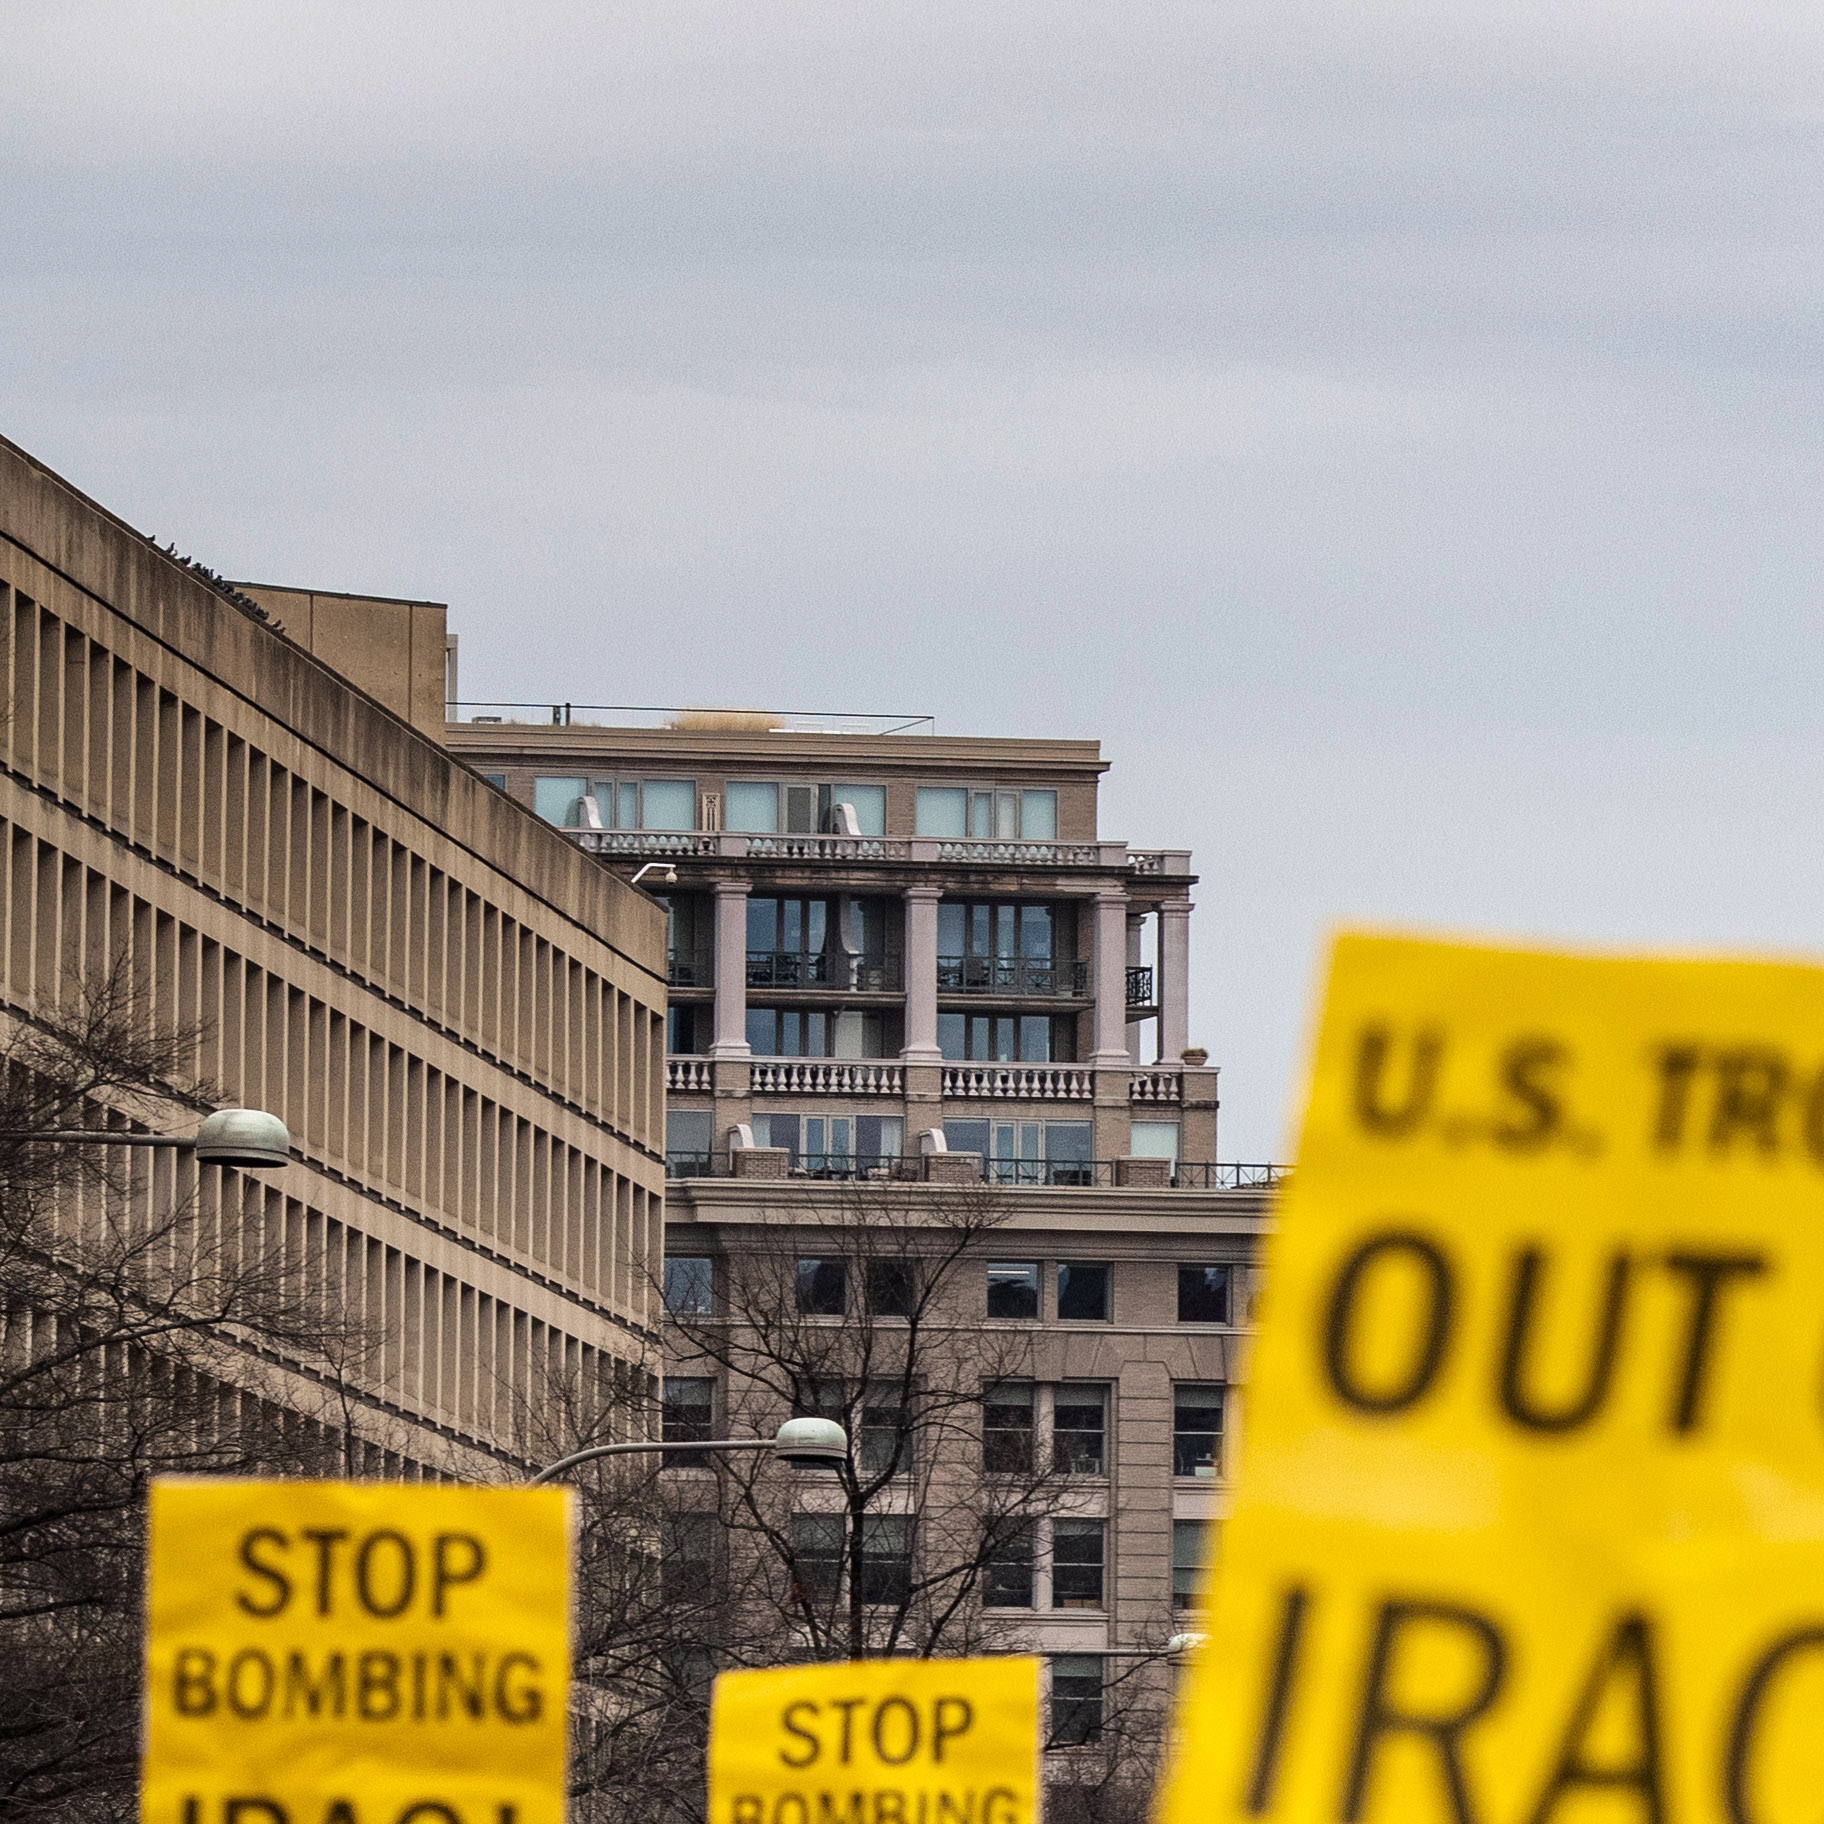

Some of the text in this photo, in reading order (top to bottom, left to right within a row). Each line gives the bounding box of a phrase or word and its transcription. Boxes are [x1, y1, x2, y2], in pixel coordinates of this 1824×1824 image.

[1350, 1014, 1597, 1167] U.S.
[1317, 1225, 1770, 1446] OUT
[233, 1526, 488, 1619] STOP
[173, 1646, 545, 1726] BOMBING
[777, 1693, 976, 1769] STOP
